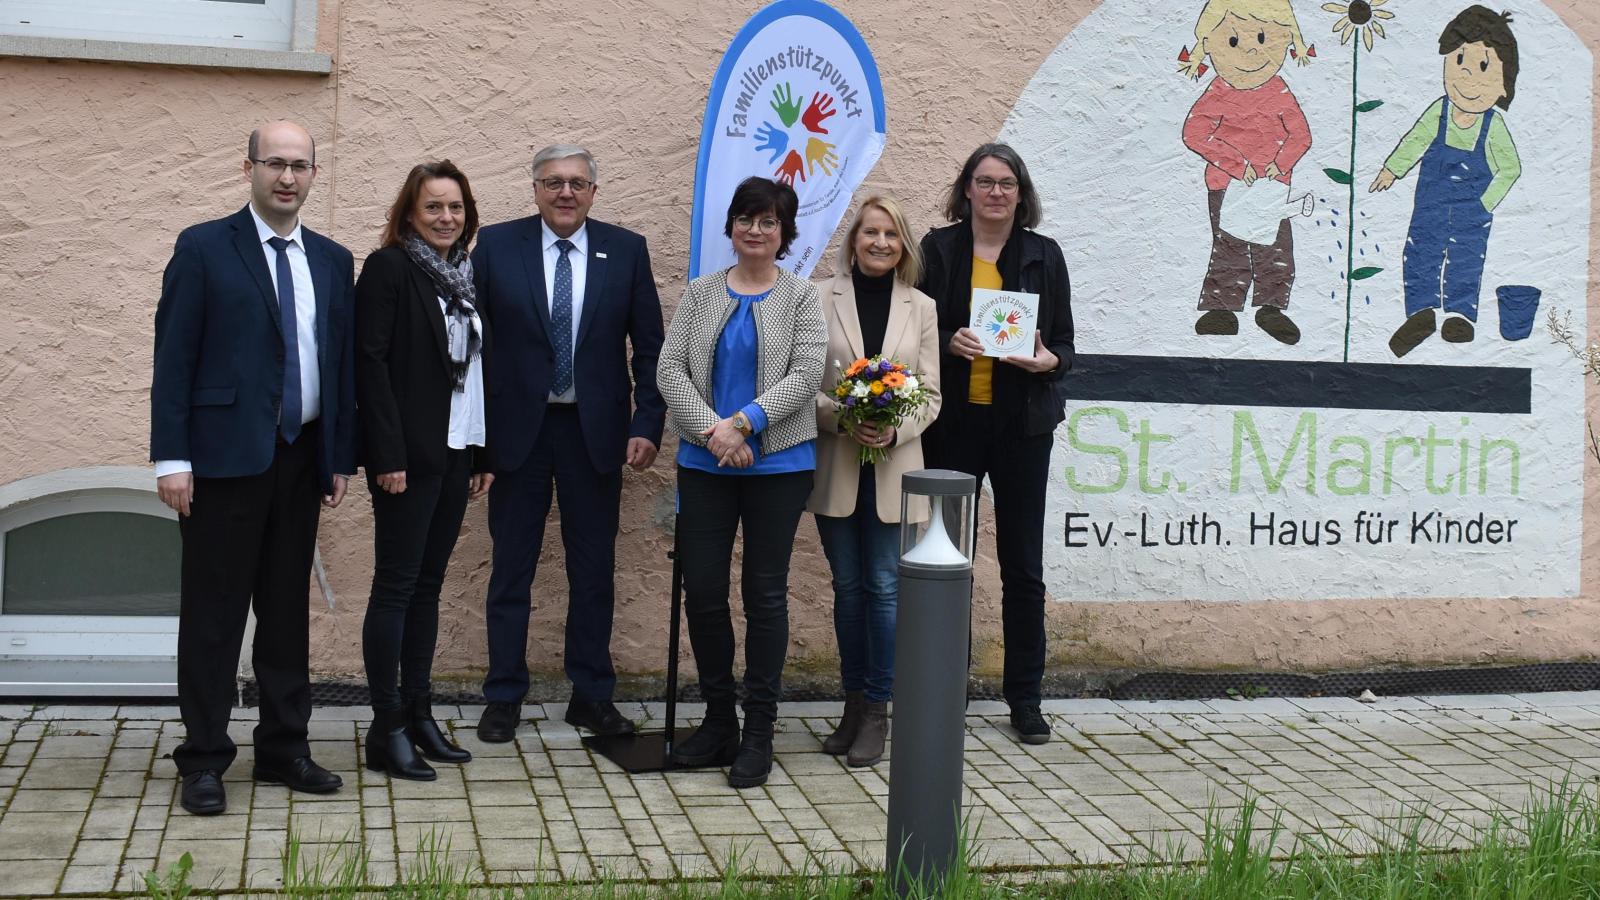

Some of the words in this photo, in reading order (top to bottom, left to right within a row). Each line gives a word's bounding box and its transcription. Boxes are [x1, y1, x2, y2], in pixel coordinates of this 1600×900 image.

[726, 45, 863, 138] Familienstützpunkt
[802, 246, 814, 262] sein
[973, 295, 1034, 328] Familienstützpunkt
[1064, 406, 1188, 495] St.
[1229, 410, 1521, 496] Martin
[1063, 511, 1231, 548] Ev.-Luth.
[1249, 511, 1342, 546] Haus
[1354, 510, 1399, 544] für
[1410, 510, 1519, 545] Kinder
